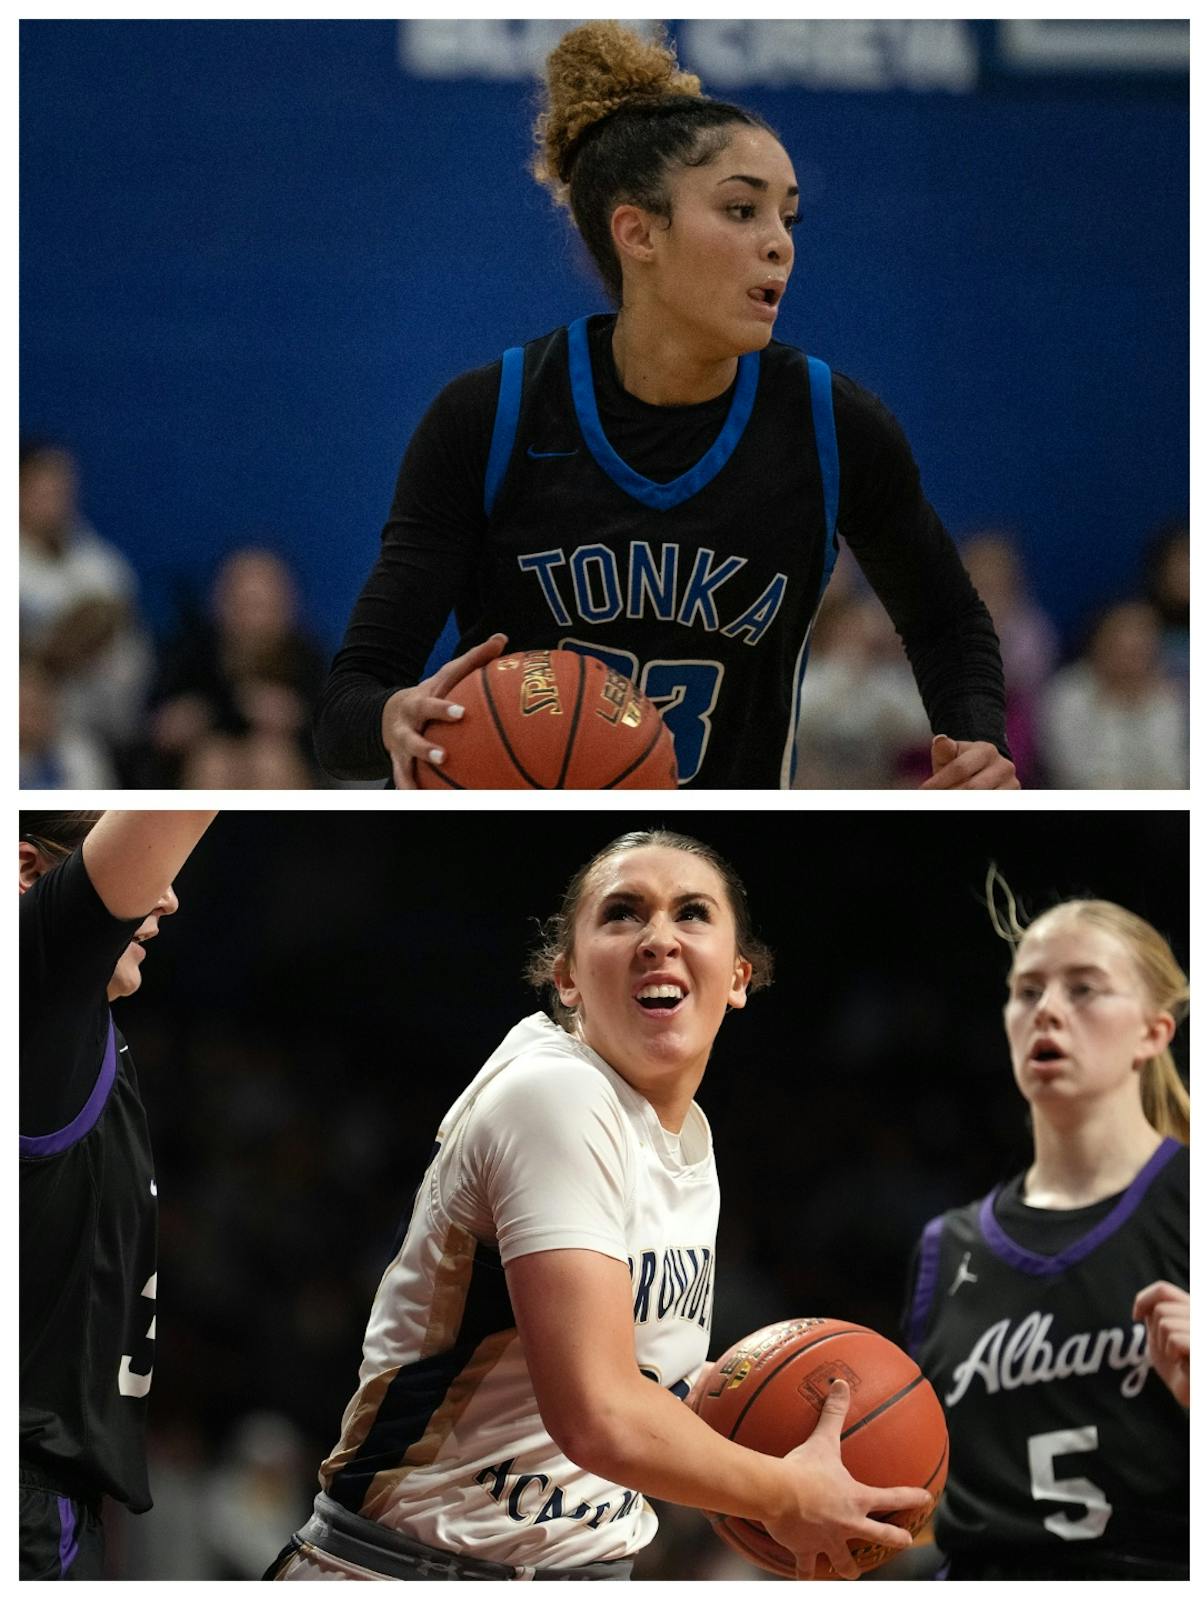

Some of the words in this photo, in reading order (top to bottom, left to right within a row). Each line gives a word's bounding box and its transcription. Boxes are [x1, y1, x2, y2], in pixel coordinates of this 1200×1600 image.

[518, 541, 788, 646] TONKA
[558, 637, 725, 785] 3
[945, 1311, 1150, 1407] Albany
[1027, 1425, 1113, 1541] 5
